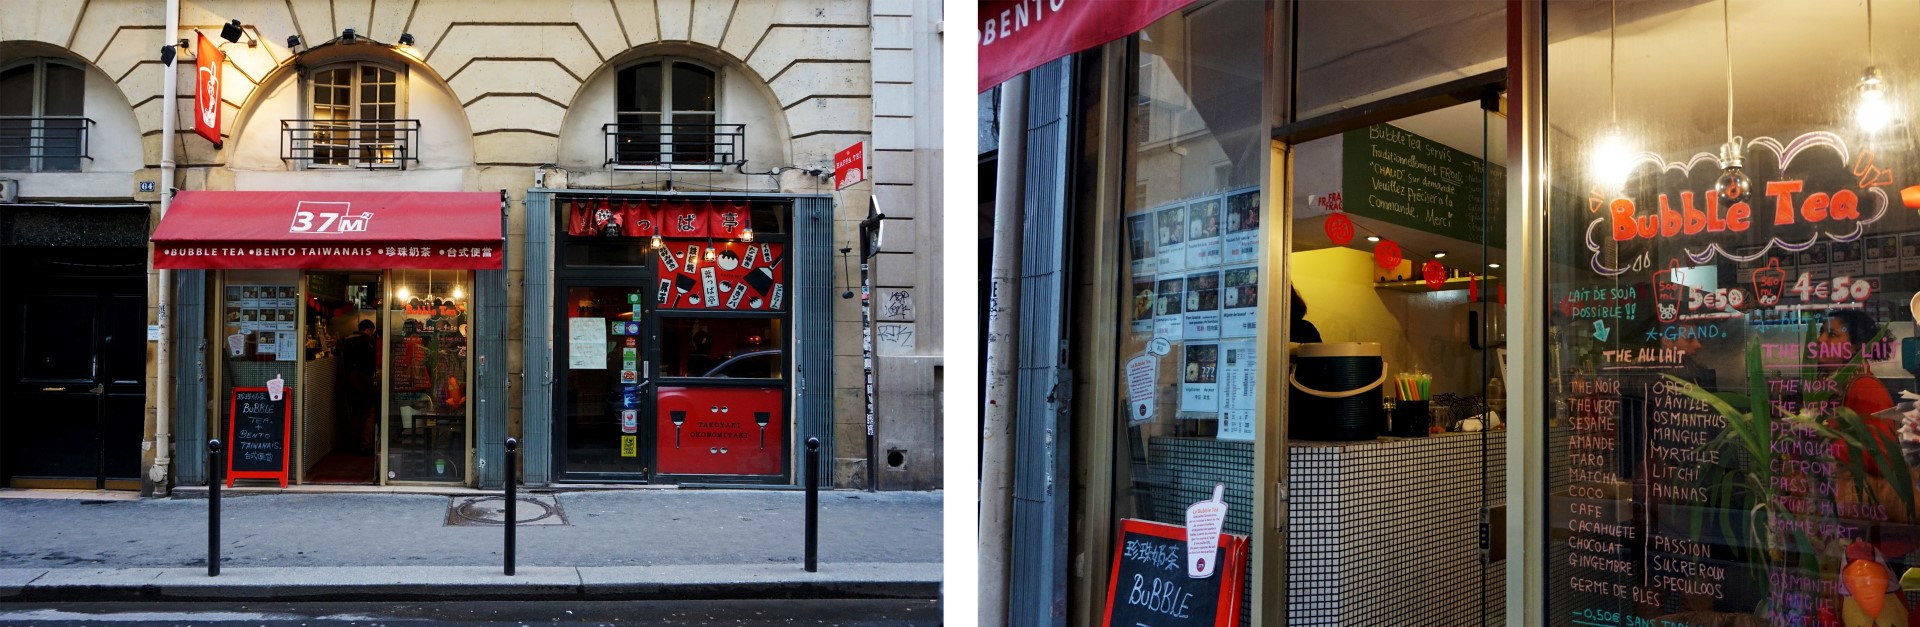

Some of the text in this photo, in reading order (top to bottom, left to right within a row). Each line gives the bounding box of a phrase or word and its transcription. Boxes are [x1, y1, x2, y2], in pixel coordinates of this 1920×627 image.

[1369, 124, 1406, 146] Bubble
[1404, 133, 1421, 151] Tea
[141, 182, 153, 190] 64
[1371, 177, 1405, 196] Veuillez
[1422, 176, 1455, 194] demande
[1610, 179, 1860, 241] Bubble Tea
[170, 247, 372, 256] BUBBLE TEA BENTO TAIWANAIS
[385, 246, 493, 258] 珍珠奶茶 台式便當
[1593, 288, 1606, 300] DE
[1658, 280, 1679, 290] 500
[406, 305, 457, 316] Bubble Tea
[1602, 346, 1686, 364] THE AU LAIT
[1761, 337, 1901, 359] THE SANS LAIT
[1570, 377, 1622, 396] THE NOIR
[1768, 376, 1838, 394] THE NOIR
[1568, 398, 1620, 415] THE VERT
[1654, 396, 1709, 412] VANILLE
[1769, 400, 1840, 417] THE VERT
[1568, 416, 1615, 431] SESAME
[1653, 410, 1727, 429] OSMANTHUS
[239, 429, 271, 439] BENTO
[1653, 428, 1707, 446] MANGUE
[1568, 436, 1615, 451] AMANDE
[1650, 438, 1720, 464] MYRTILLE
[1770, 440, 1844, 457] KUMQUAT
[1569, 453, 1604, 466] TARO
[1770, 459, 1833, 477] CITRON
[1569, 467, 1618, 486] MATCHA
[1653, 463, 1701, 481] LITCHI
[1568, 484, 1604, 499] COCO
[1653, 482, 1708, 502] ANANAS
[1770, 476, 1839, 497] PASSION
[1570, 502, 1603, 518] CAFE
[1568, 519, 1636, 539] CACAHUETE
[1568, 535, 1623, 555] CHOCOLAT
[1655, 535, 1711, 559] PASSION
[1124, 539, 1180, 571] 珍珠奶茶
[1568, 552, 1633, 576] GINGEMBRE
[1653, 554, 1725, 580] SUCRE ROUX
[1570, 576, 1609, 596] GERME
[1613, 583, 1628, 599] DE
[1653, 574, 1724, 599] SPECULOOS
[1626, 615, 1656, 627] SANS
